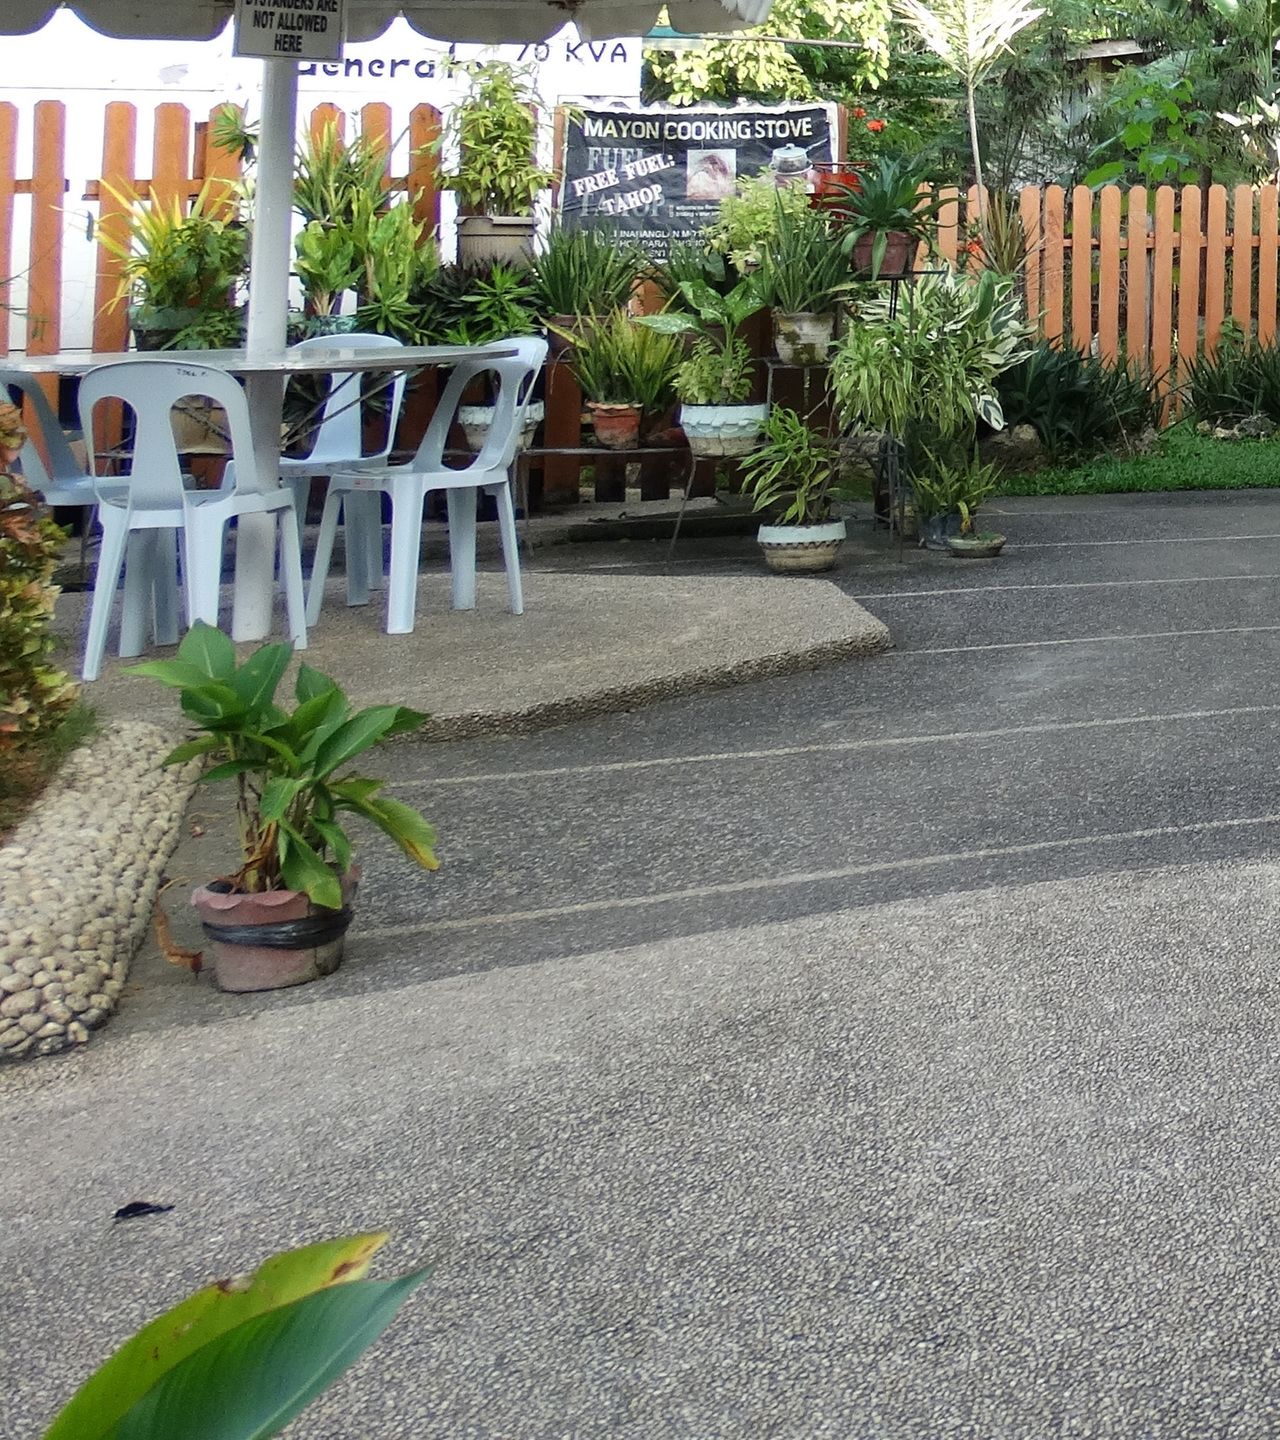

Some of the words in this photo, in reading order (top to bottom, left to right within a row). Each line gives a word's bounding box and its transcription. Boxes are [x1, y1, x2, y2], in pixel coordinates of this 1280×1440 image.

[253, 10, 275, 29] NOT
[277, 13, 327, 32] ALLOWED
[274, 33, 302, 52] HERE
[565, 42, 627, 62] KVA
[584, 118, 660, 139] MAYON
[664, 121, 750, 140] COOKING
[754, 117, 813, 139] STOVE
[572, 169, 620, 197] FREE
[625, 153, 675, 180] FUEL:
[602, 184, 662, 214] TAHOP
